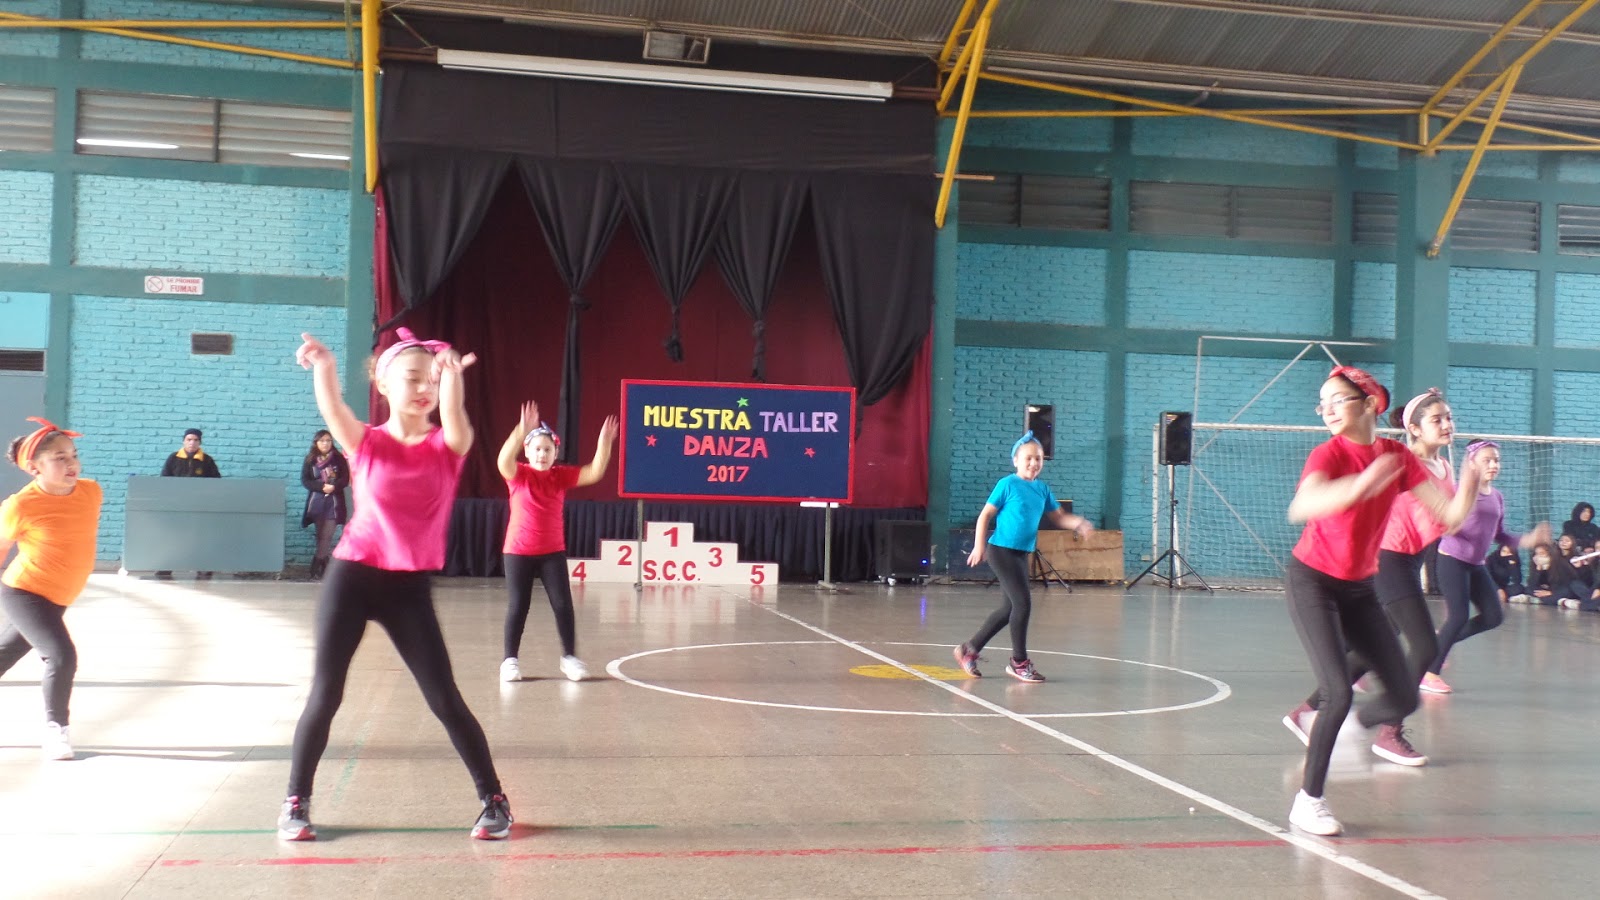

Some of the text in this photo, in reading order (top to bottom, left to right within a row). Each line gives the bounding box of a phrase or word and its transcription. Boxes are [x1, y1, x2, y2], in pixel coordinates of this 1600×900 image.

[170, 285, 198, 293] FUMAR
[643, 405, 838, 432] MUESTRA TALLER
[683, 435, 768, 458] DANZA
[707, 465, 749, 482] 2017
[663, 527, 679, 547] 1
[617, 545, 632, 566] 2
[708, 547, 723, 567] 3
[571, 562, 587, 581] 4
[643, 560, 701, 581] S.C.C.
[750, 565, 765, 585] 5
